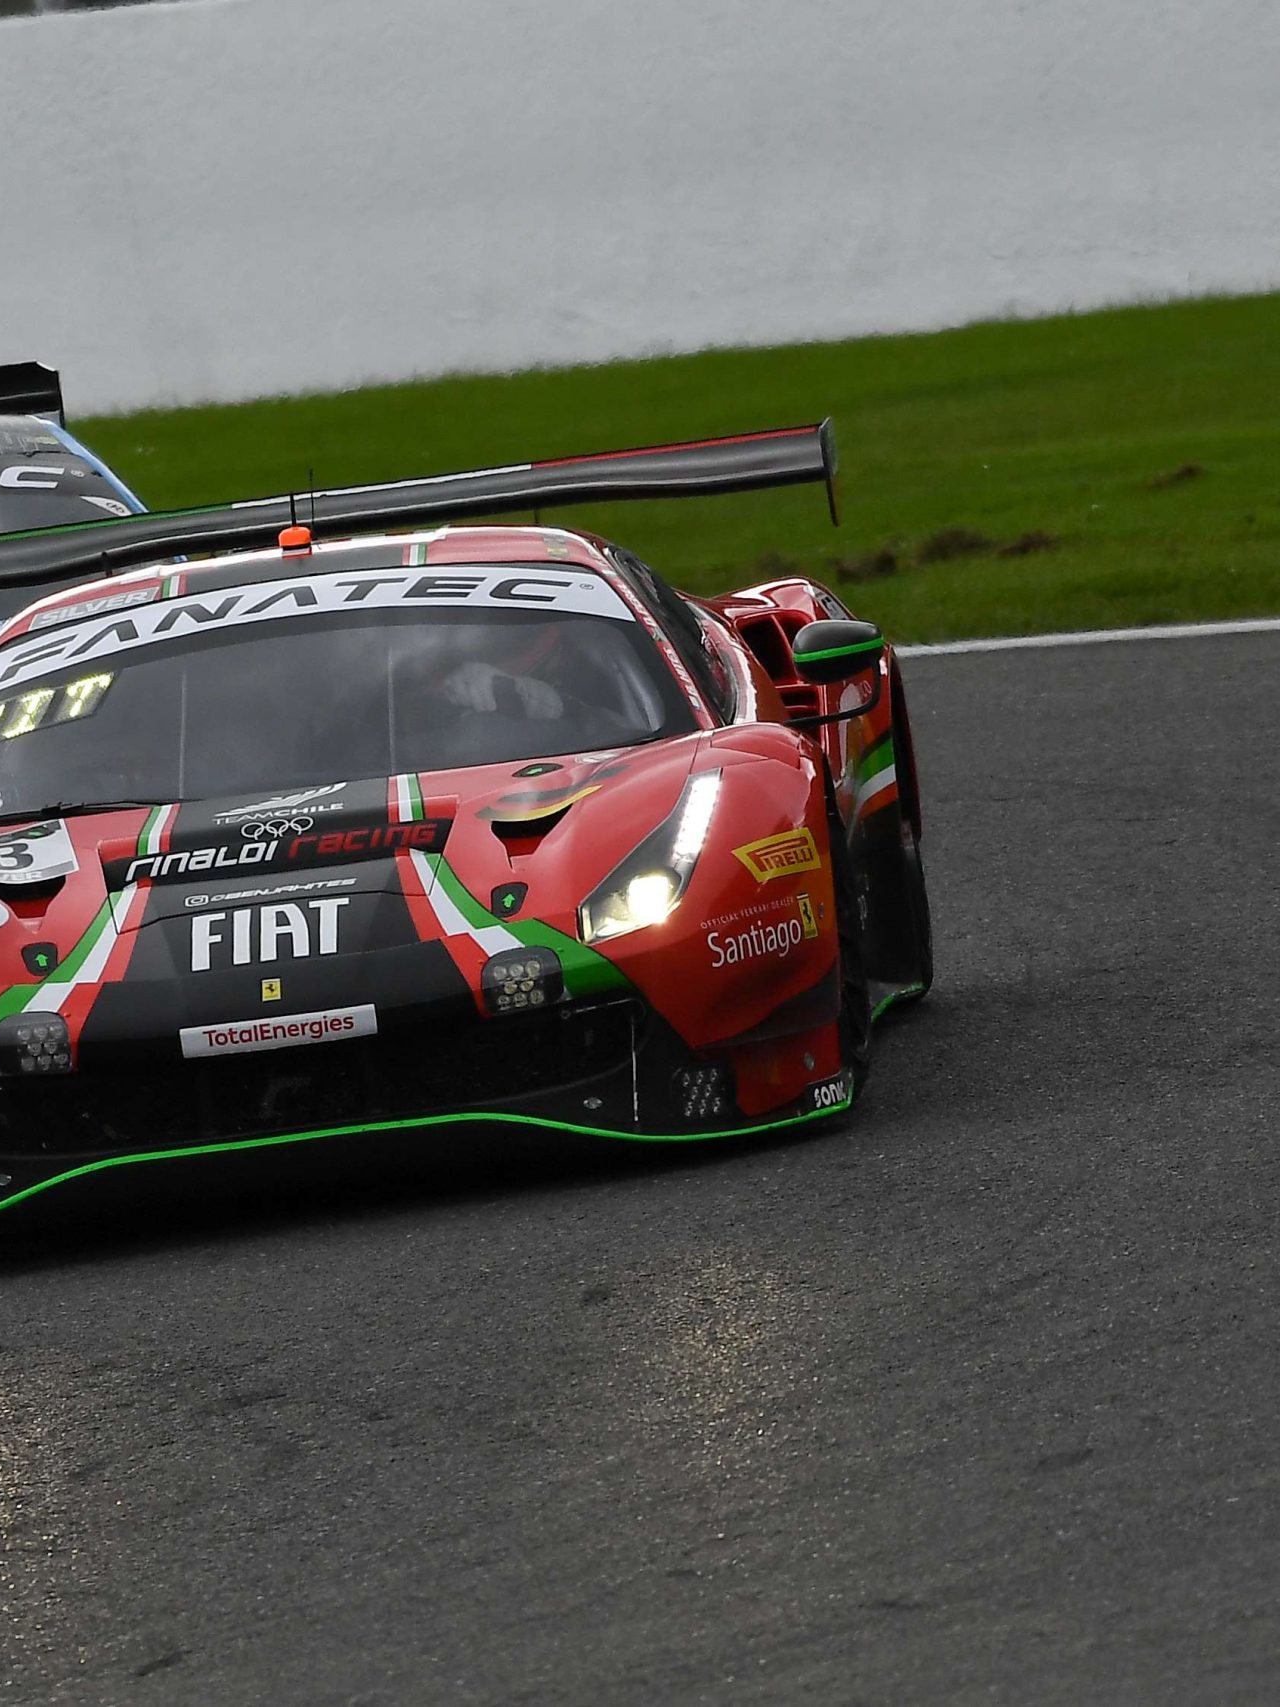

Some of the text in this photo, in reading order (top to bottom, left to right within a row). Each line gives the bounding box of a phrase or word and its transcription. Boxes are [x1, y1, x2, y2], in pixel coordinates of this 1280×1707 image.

[37, 589, 150, 627] SILVER
[747, 836, 815, 872] PIRELLI
[190, 897, 350, 973] FIAT
[700, 913, 739, 930] OFFICIAL
[740, 904, 769, 918] FERRARI
[706, 918, 802, 968] Santiago
[202, 1013, 355, 1048] TotalEnergies
